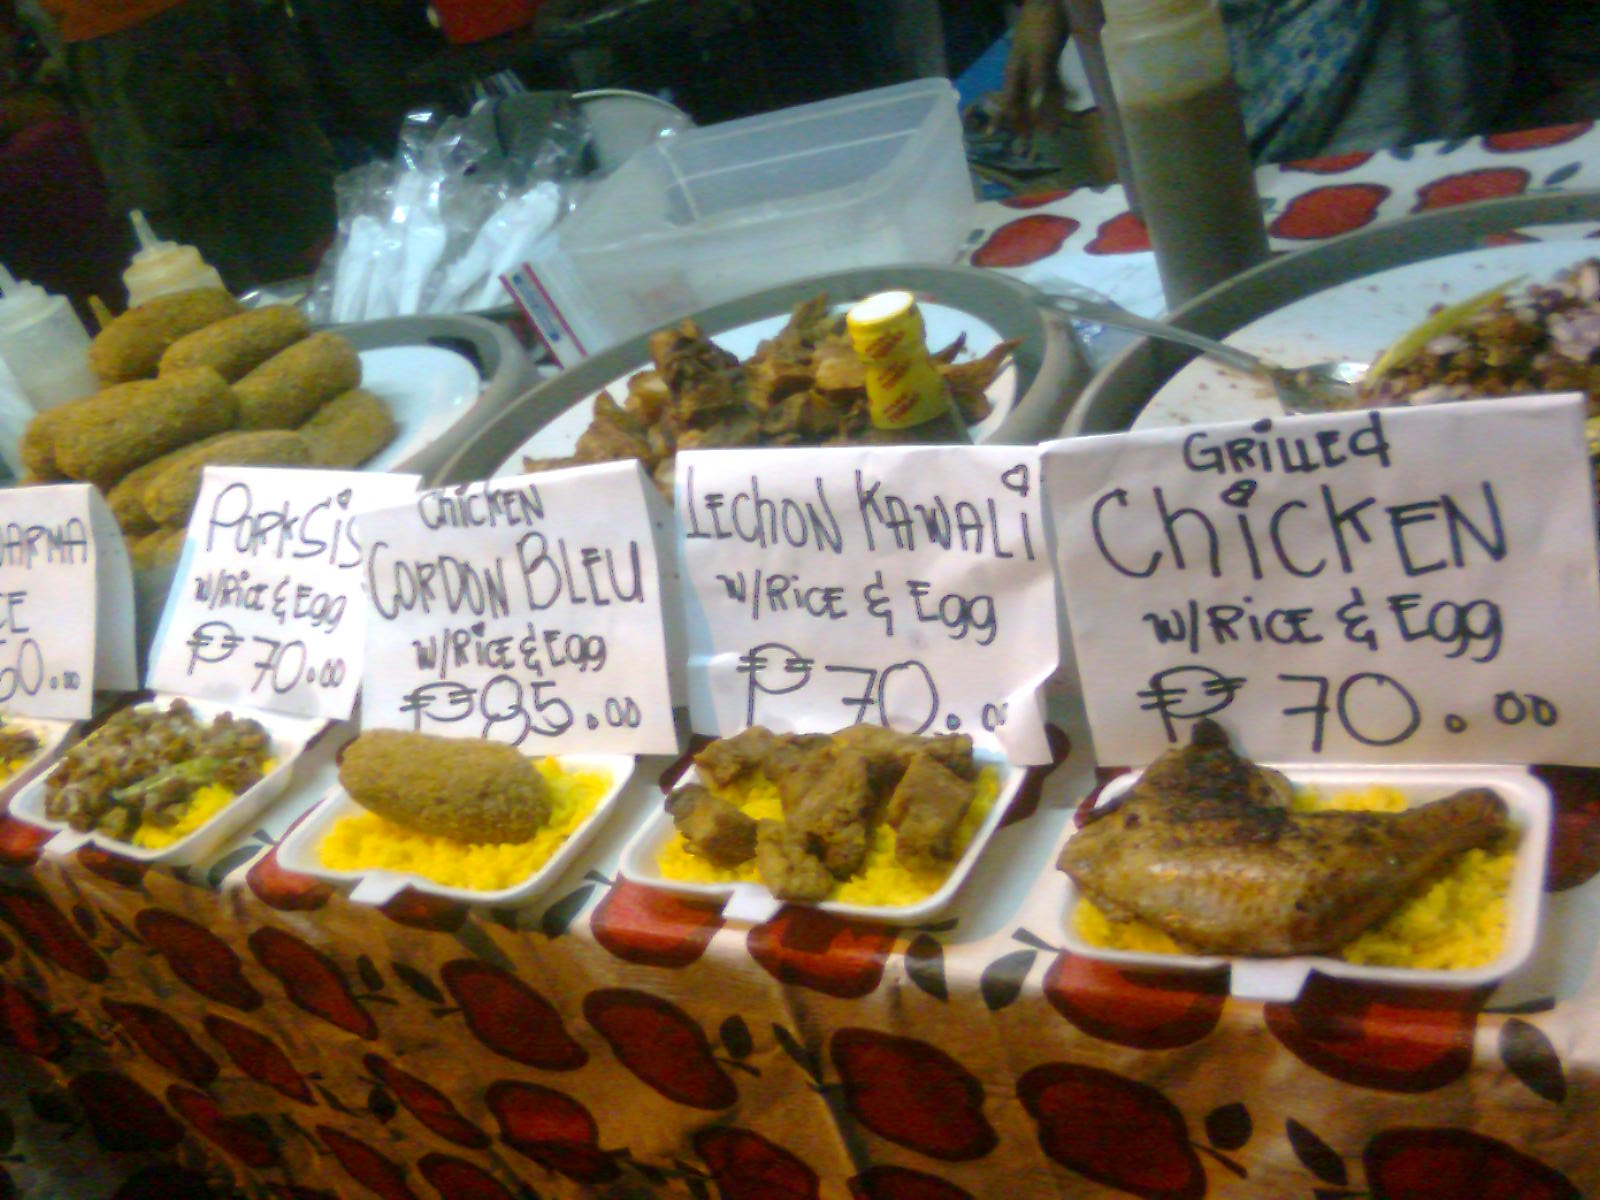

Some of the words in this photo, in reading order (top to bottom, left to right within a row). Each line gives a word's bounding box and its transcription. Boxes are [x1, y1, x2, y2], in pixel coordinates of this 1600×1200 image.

[1183, 411, 1391, 474] GRiLLEd
[417, 481, 545, 530] ChiCKEN
[686, 466, 843, 554] LEChON
[855, 463, 1036, 561] KAWALi
[1092, 480, 1507, 580] ChiCKEN
[294, 583, 347, 634] Egg
[368, 541, 510, 620] CORDON
[516, 531, 645, 611] BLEU
[906, 580, 998, 646] Egg
[1387, 593, 1503, 662] Egg
[543, 629, 607, 673] Egg
